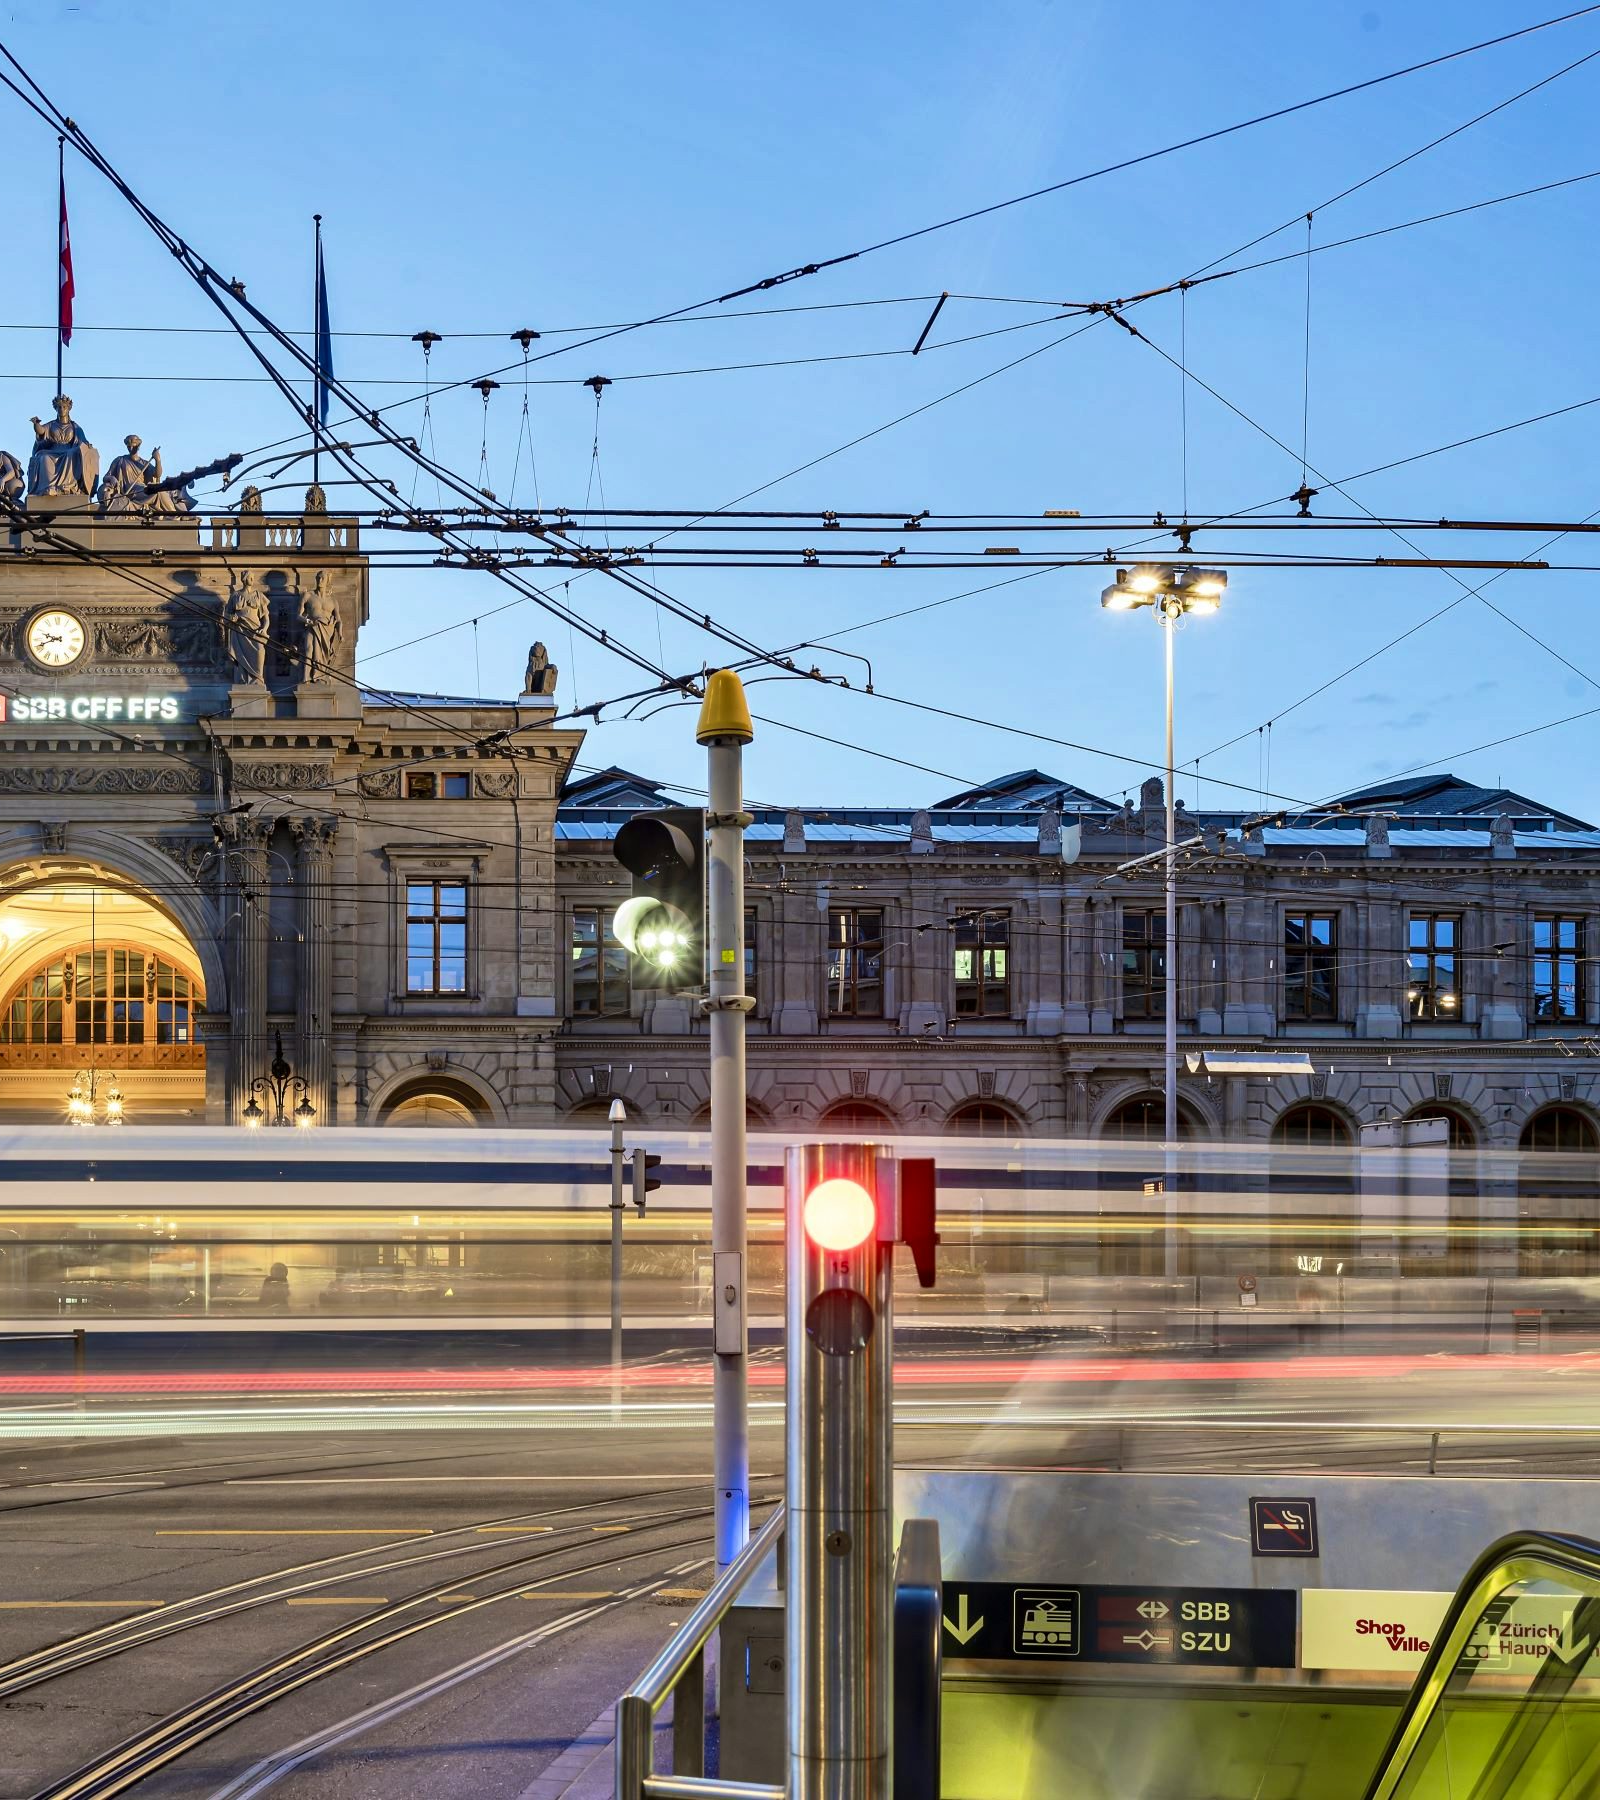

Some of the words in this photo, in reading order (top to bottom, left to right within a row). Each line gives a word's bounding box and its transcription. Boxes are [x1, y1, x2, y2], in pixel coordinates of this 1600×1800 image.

[12, 697, 66, 719] SBB
[71, 697, 123, 719] CFF
[127, 697, 179, 719] FFS
[832, 1261, 849, 1274] 15
[1181, 1601, 1230, 1621] SBB
[1355, 1619, 1405, 1641] Shop
[1500, 1623, 1560, 1638] Zürich
[1181, 1631, 1231, 1651] SZU
[1386, 1636, 1430, 1652] Ville
